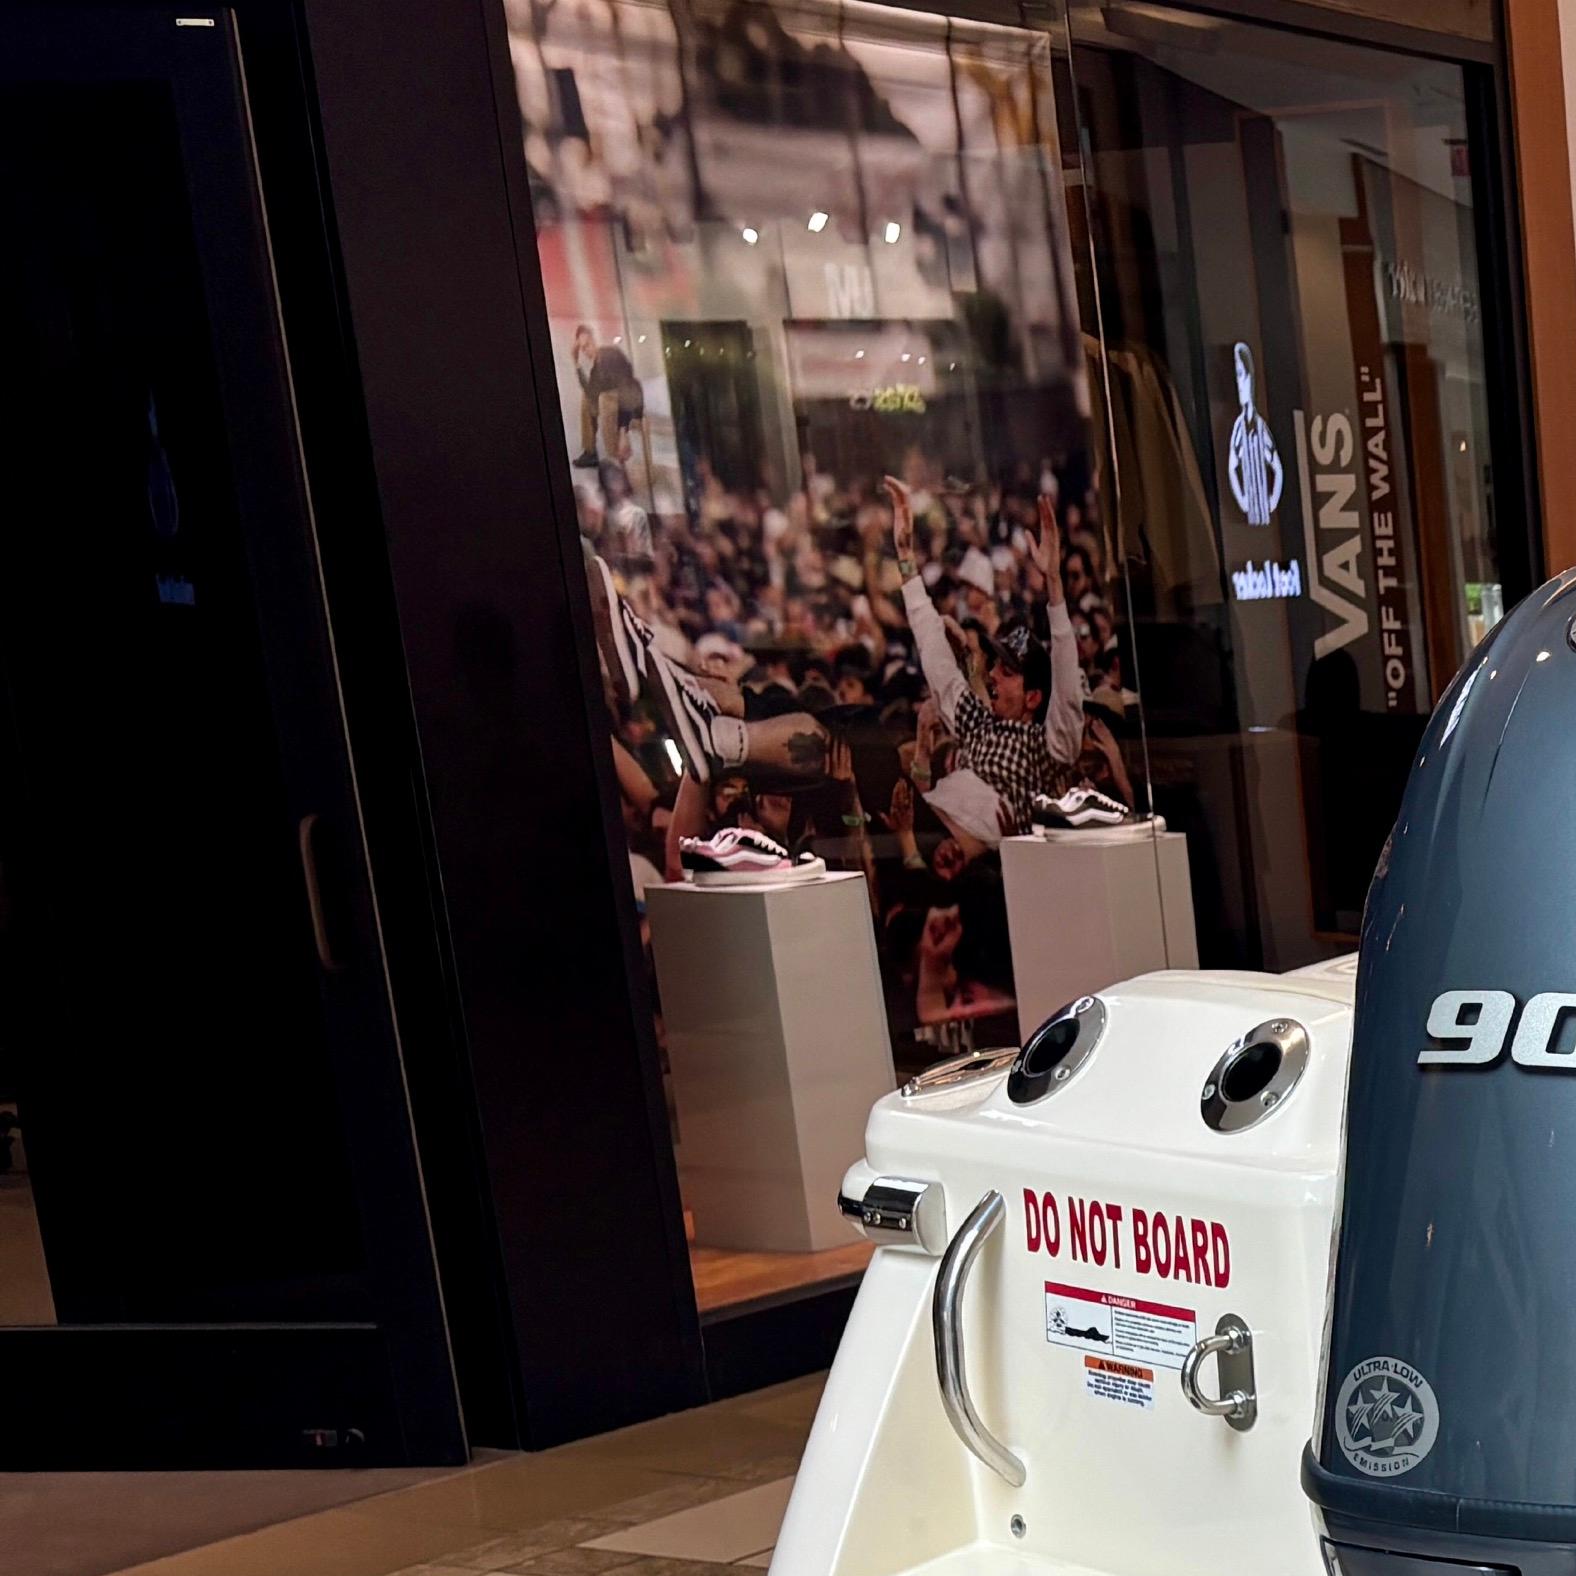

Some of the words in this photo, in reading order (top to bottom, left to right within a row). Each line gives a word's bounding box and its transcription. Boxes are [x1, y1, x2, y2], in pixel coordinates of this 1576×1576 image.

[1293, 409, 1369, 661] VANS
[1373, 511, 1399, 594] THE
[1023, 1187, 1061, 1258] DO
[1068, 1196, 1123, 1270] NOT
[1132, 1207, 1231, 1289] BOARD
[1108, 1295, 1137, 1310] DANGER
[1106, 1361, 1142, 1378] WARNING
[1353, 1453, 1410, 1472] EMISSION
